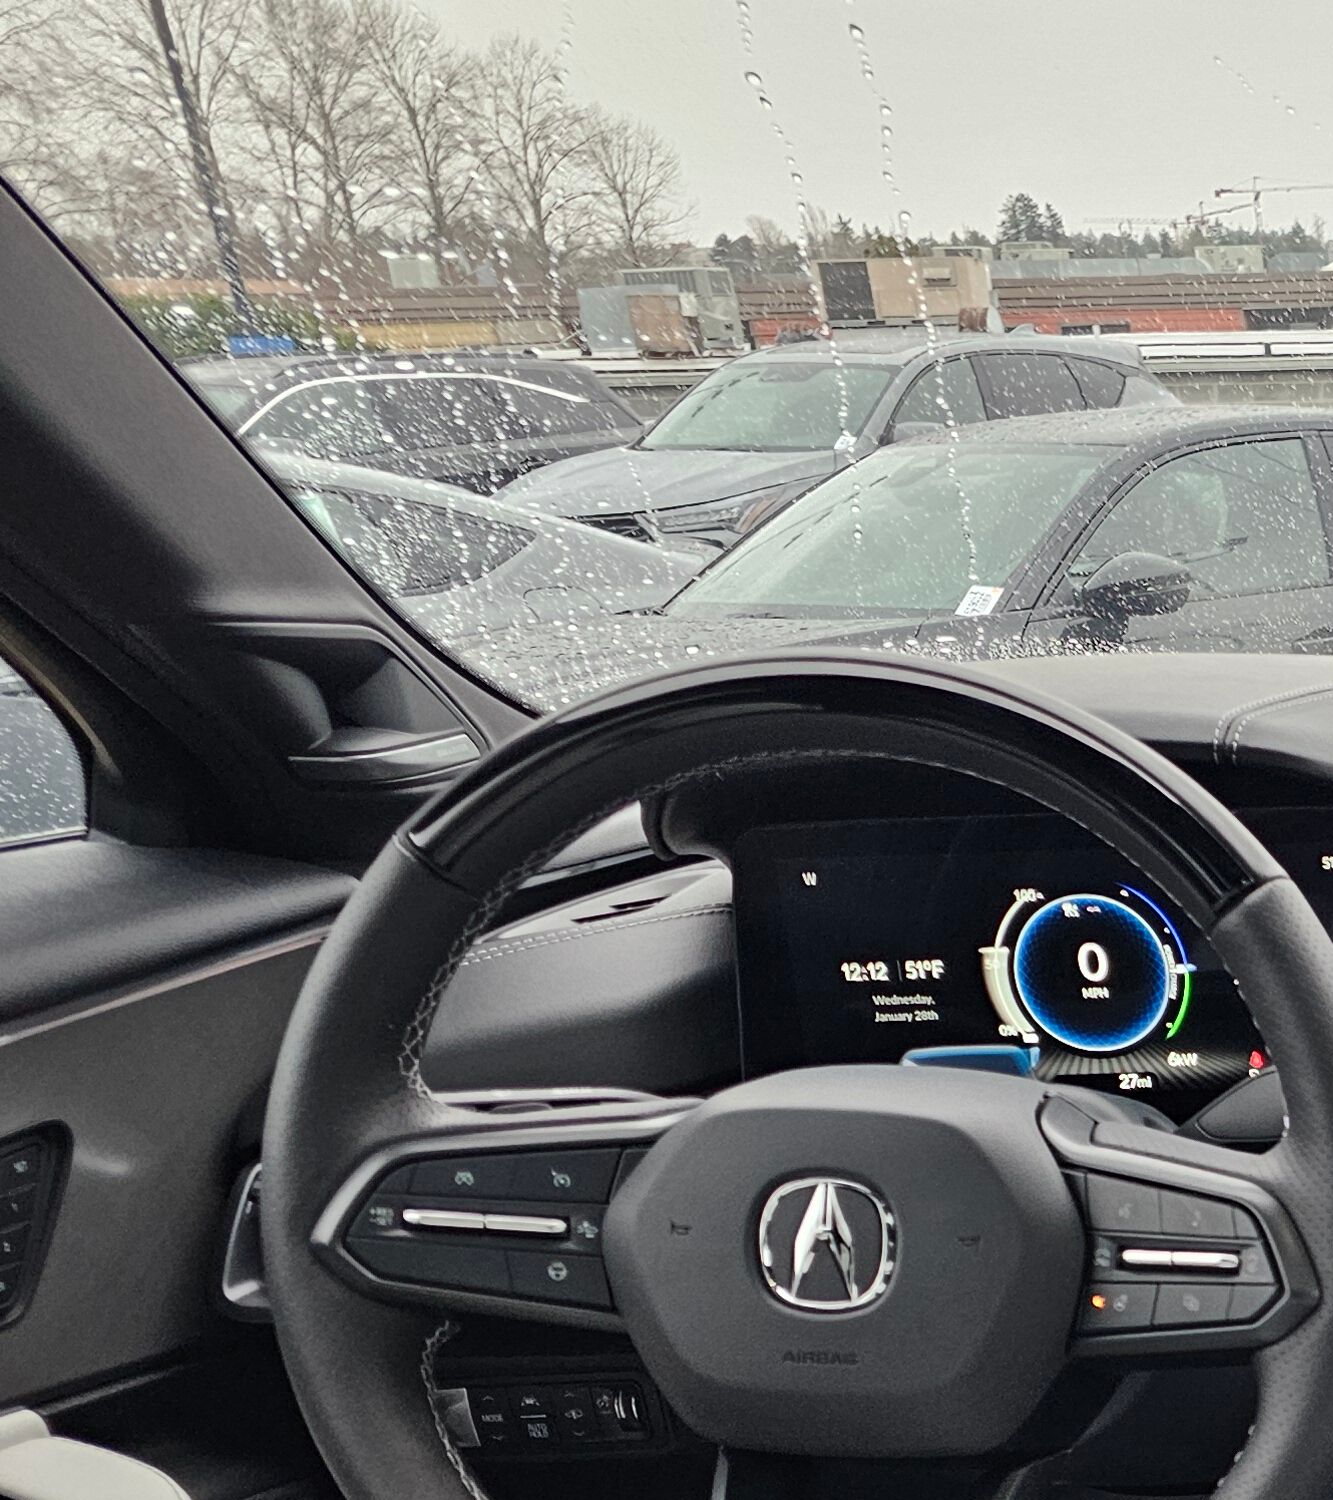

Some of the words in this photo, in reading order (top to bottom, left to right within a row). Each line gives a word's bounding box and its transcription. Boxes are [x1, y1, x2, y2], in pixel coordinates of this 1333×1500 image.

[840, 961, 891, 982] 12:12
[1077, 942, 1109, 982] 0
[875, 1011, 912, 1023] January
[915, 1010, 939, 1021] 28th
